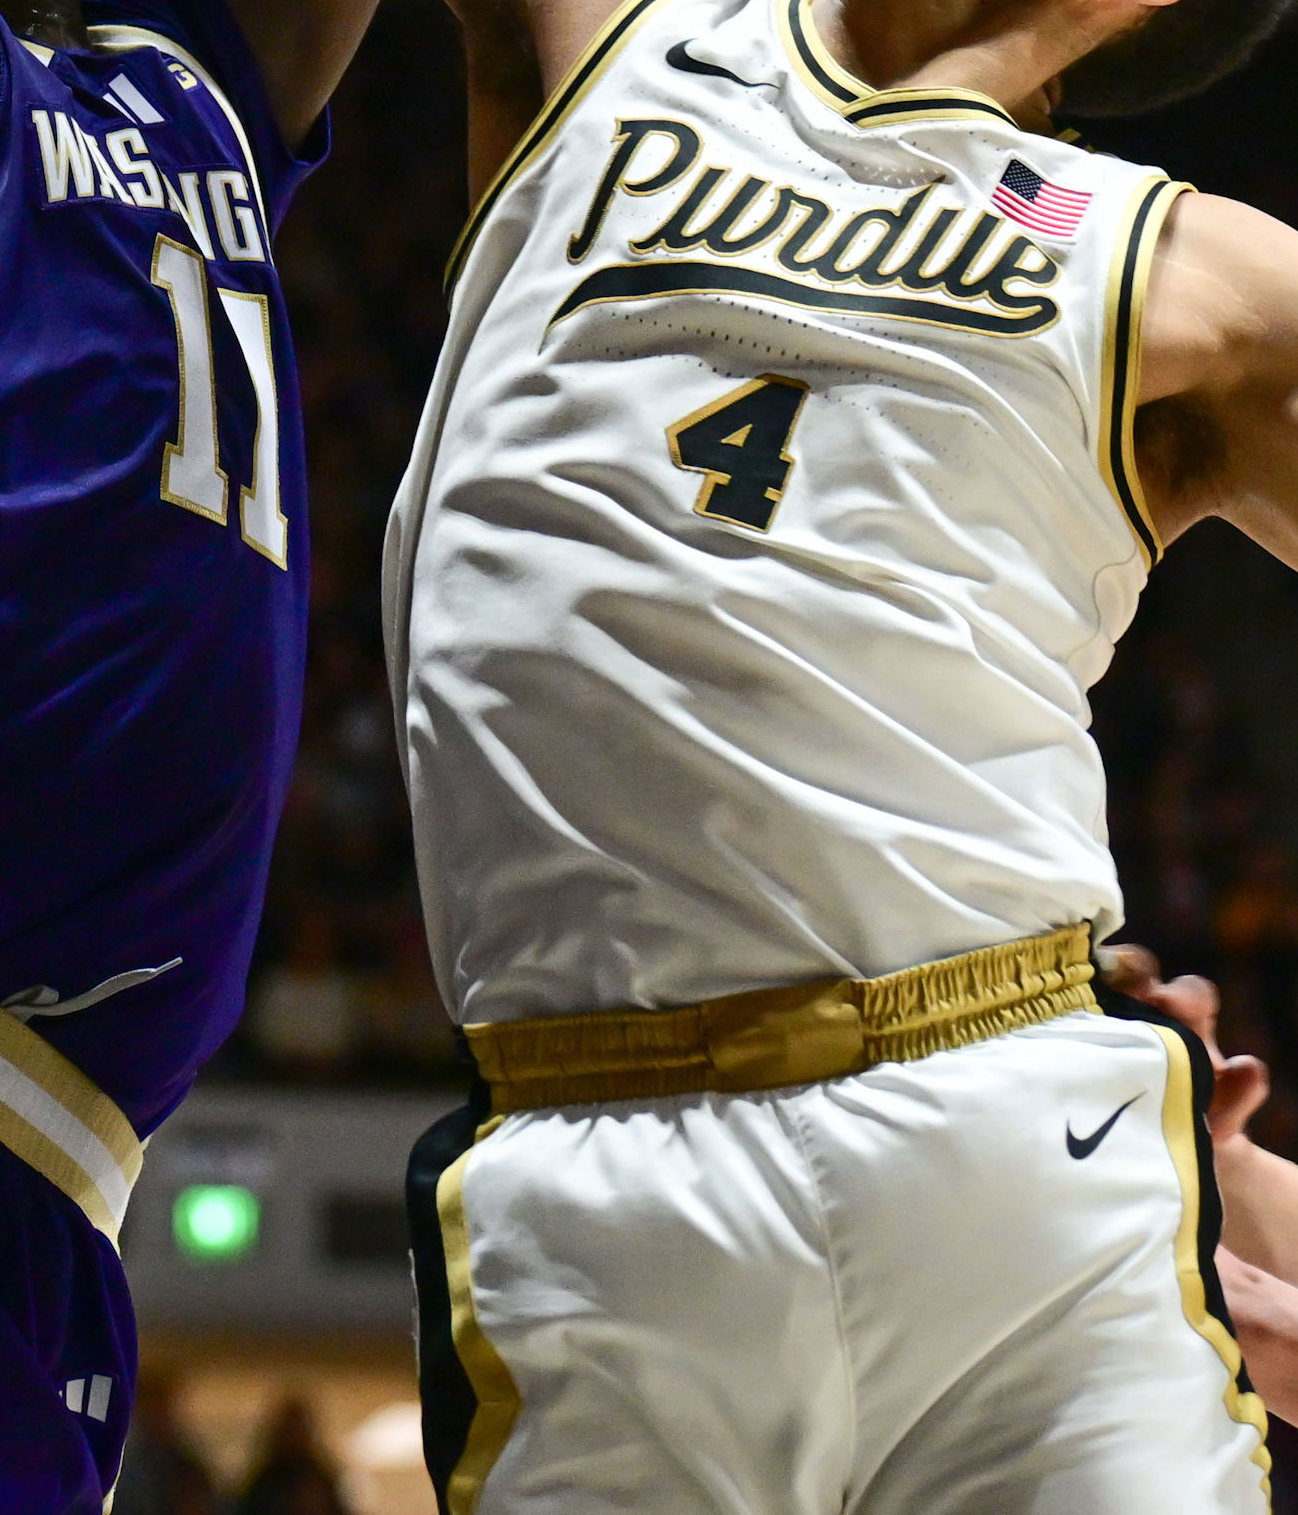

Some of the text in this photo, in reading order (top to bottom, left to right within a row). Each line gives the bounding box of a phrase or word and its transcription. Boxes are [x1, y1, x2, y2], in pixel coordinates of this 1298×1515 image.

[564, 117, 1064, 321] Purdue
[150, 232, 288, 571] 11
[665, 373, 811, 533] 4
